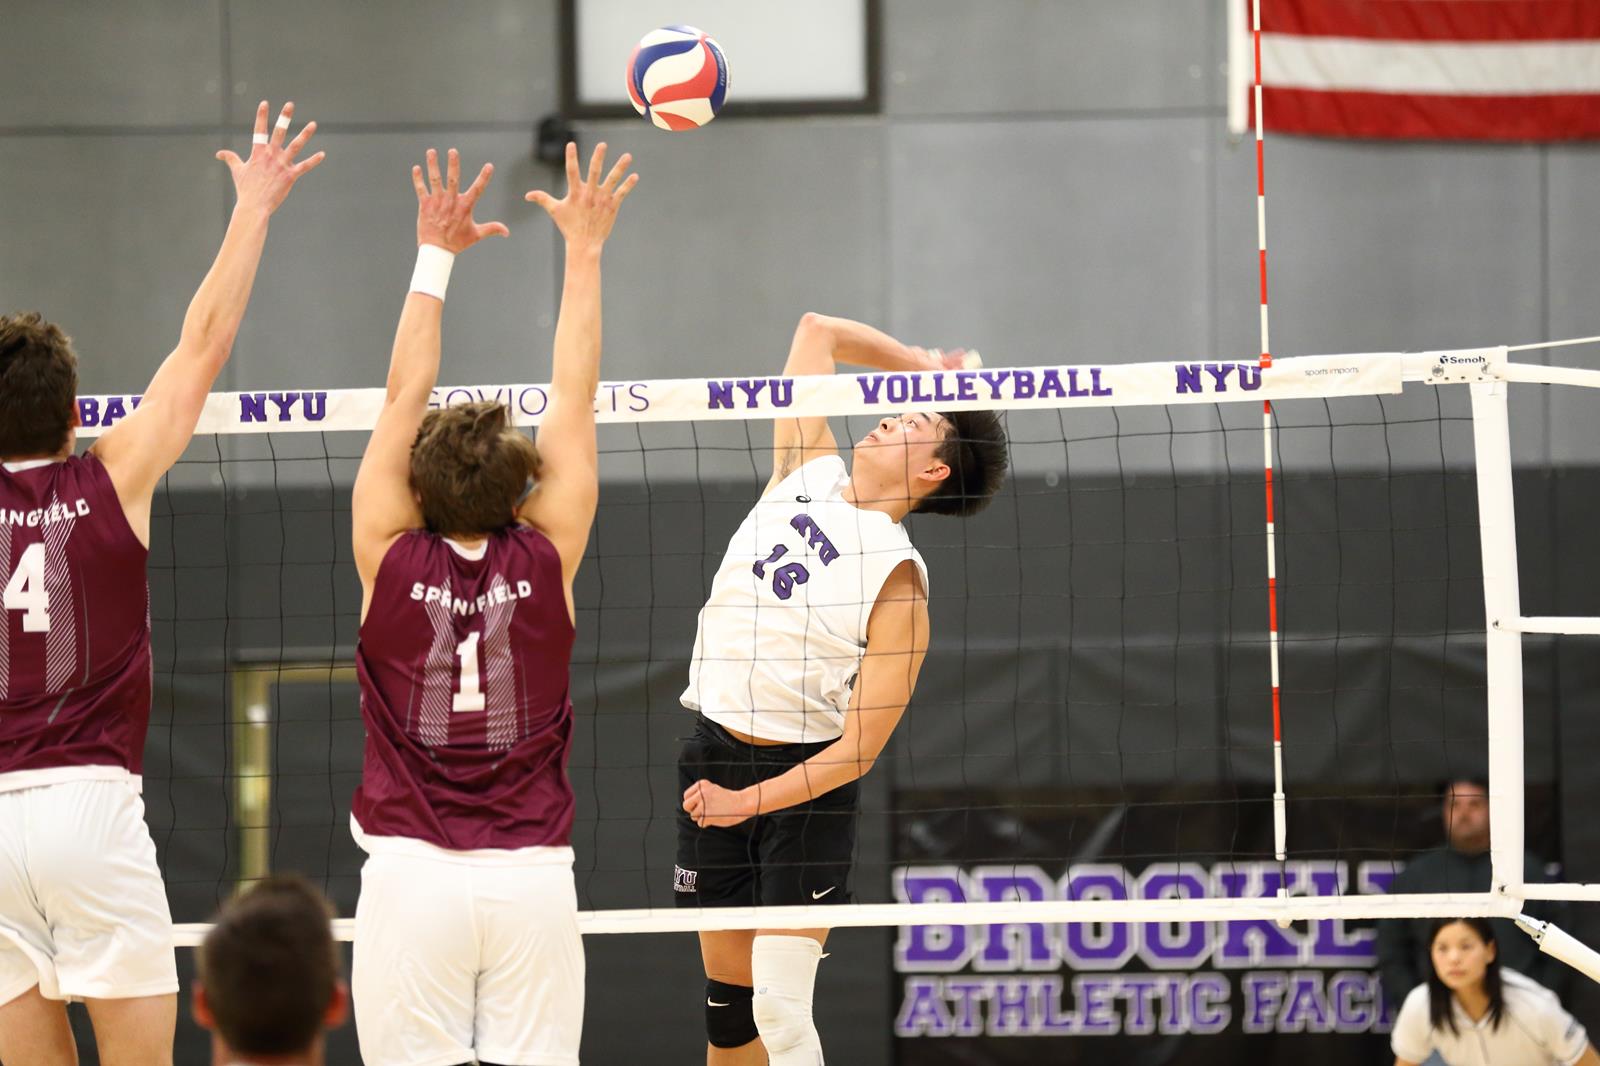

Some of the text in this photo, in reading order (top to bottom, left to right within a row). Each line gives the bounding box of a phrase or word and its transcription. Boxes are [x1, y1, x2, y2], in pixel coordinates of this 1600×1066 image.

[1449, 355, 1486, 364] Senoh
[239, 392, 327, 422] NYU
[707, 379, 794, 409] NYU
[857, 368, 1113, 404] VOLLEYBALL
[1175, 363, 1263, 394] NYU
[3, 542, 51, 633] 4
[410, 580, 532, 617] SPRNFIELD
[752, 544, 810, 601] 16
[452, 631, 486, 713] 1
[895, 973, 1232, 1037] ATHLETIC
